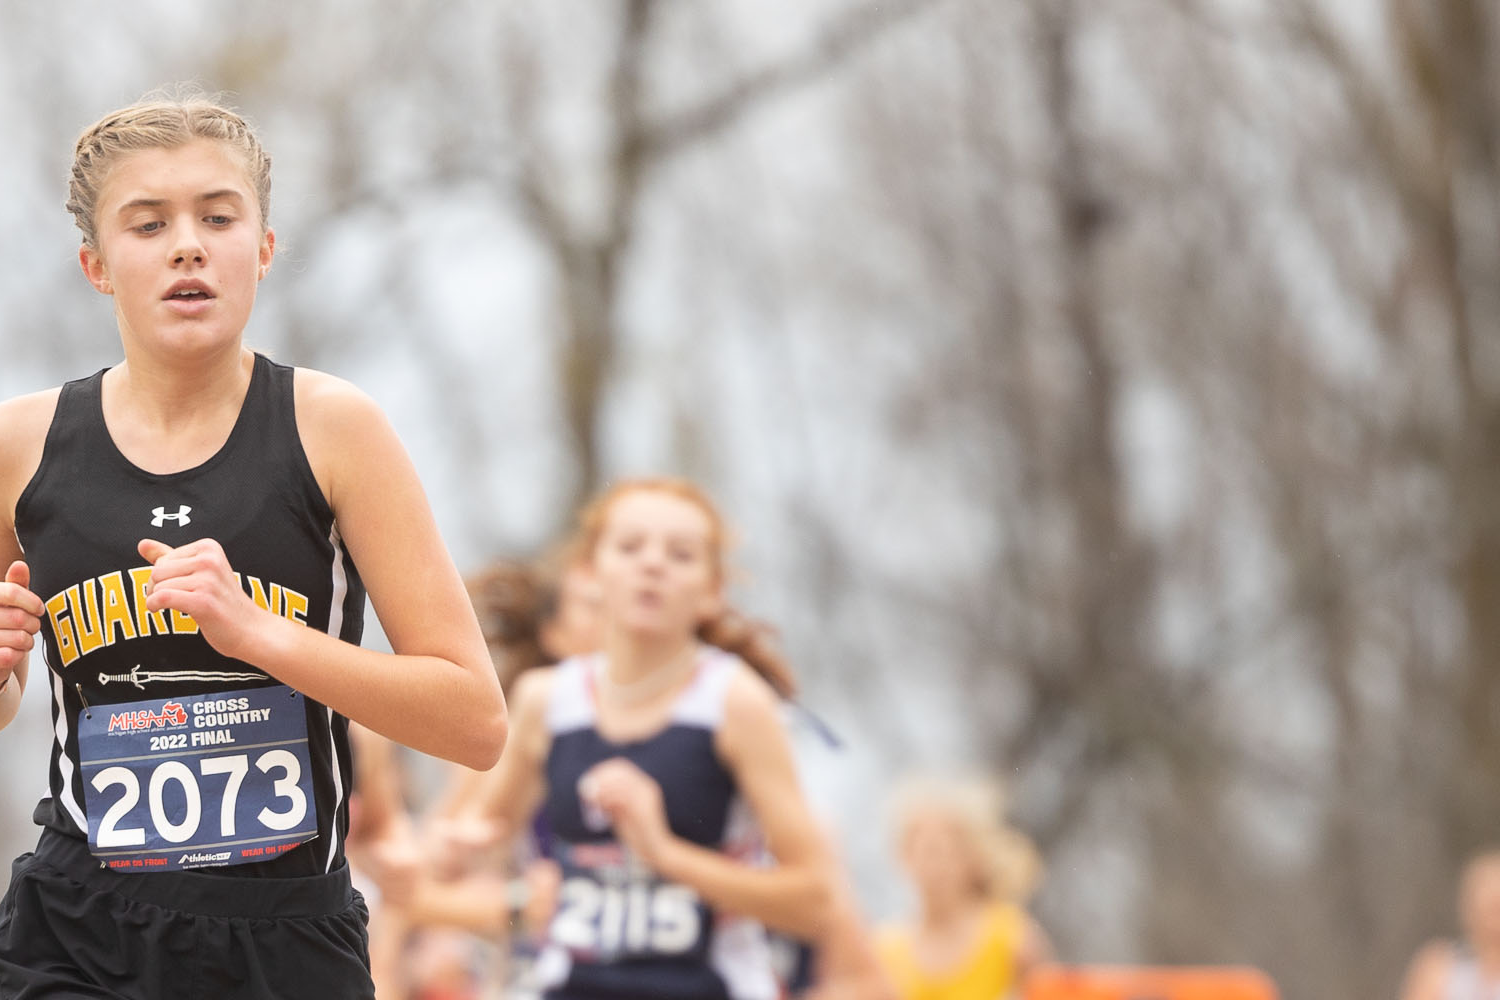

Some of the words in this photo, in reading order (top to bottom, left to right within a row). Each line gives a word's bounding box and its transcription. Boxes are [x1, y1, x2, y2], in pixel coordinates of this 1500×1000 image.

[193, 697, 249, 714] CROSS
[108, 707, 177, 732] MHSAA
[194, 708, 271, 728] COUNTRY
[150, 734, 188, 751] 2022
[191, 729, 236, 747] FINAL
[91, 749, 307, 848] 2073
[553, 877, 700, 956] 2115
